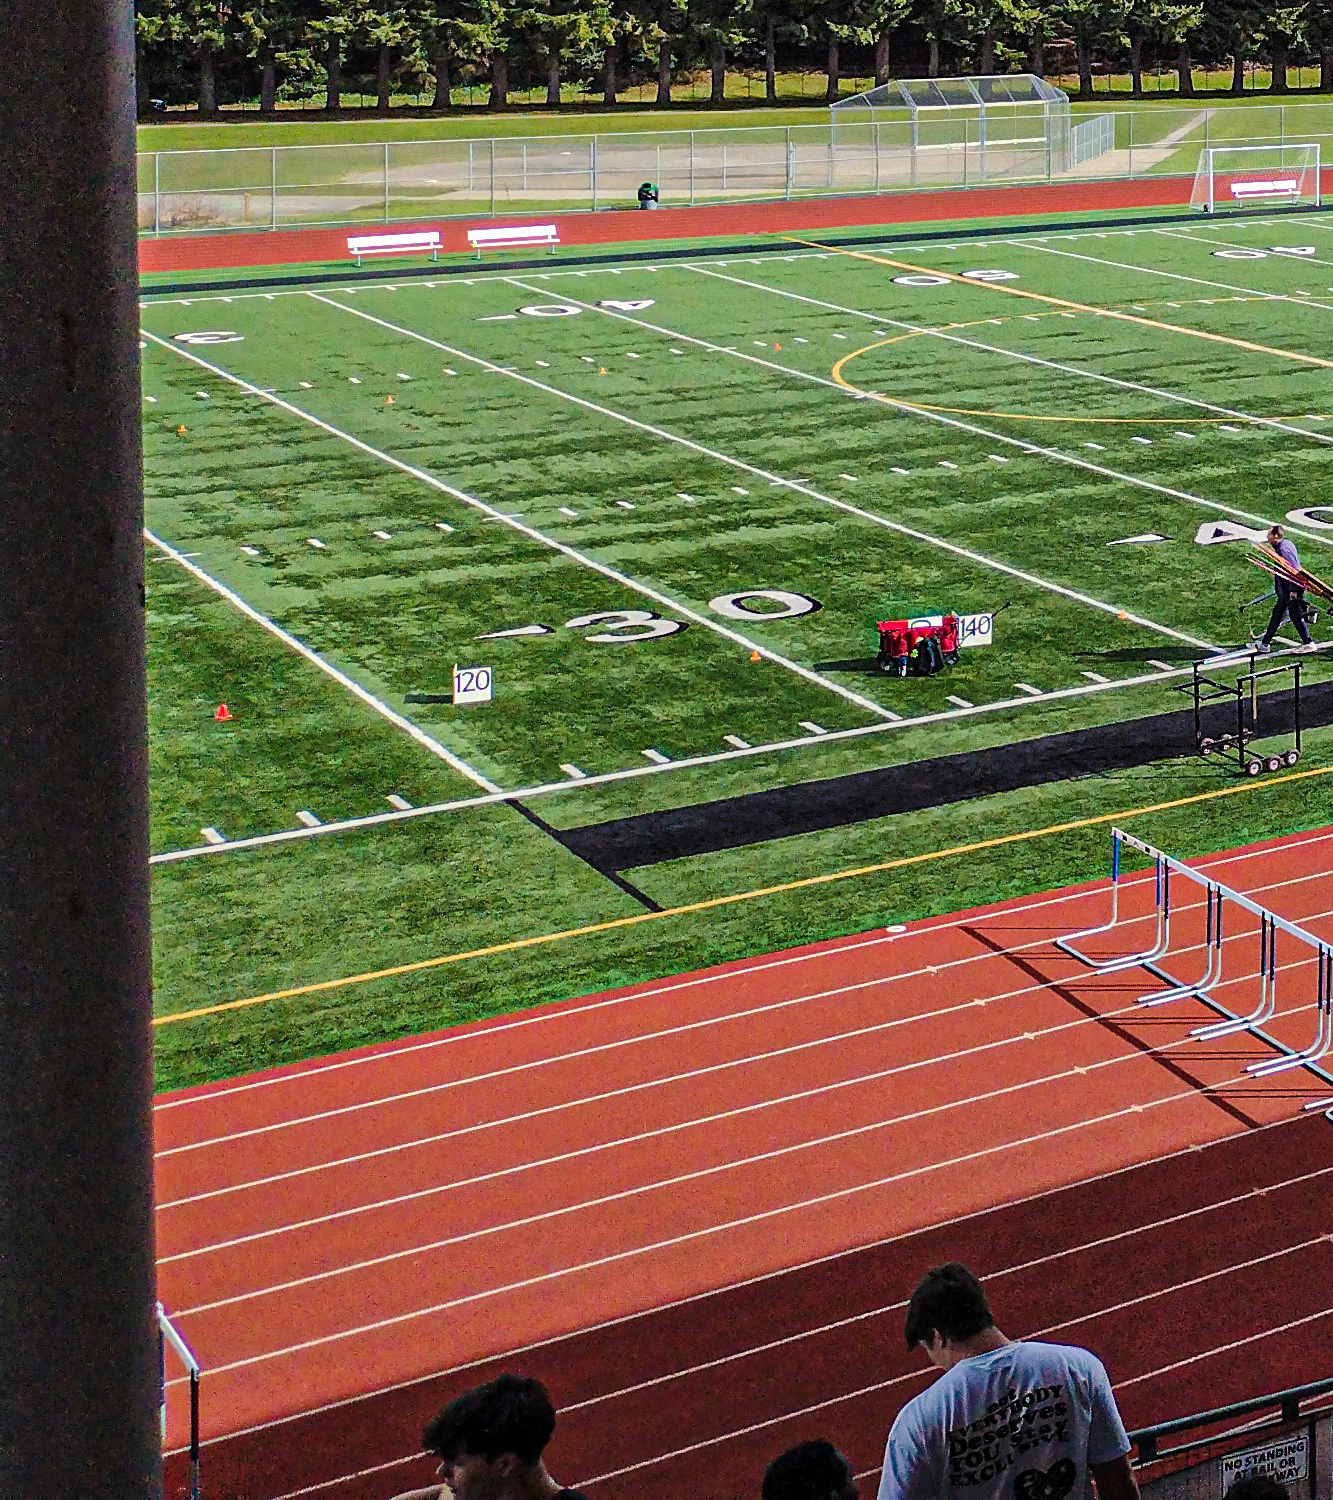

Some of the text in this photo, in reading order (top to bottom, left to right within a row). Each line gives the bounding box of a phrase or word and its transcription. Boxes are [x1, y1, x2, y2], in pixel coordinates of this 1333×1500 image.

[564, 589, 823, 644] 30
[959, 615, 991, 638] 140
[454, 669, 490, 694] 120
[949, 1442, 1000, 1473] YOU
[1224, 1441, 1305, 1472] NO STANDING
[1233, 1468, 1248, 1481] AT
[1279, 1456, 1296, 1469] OR
